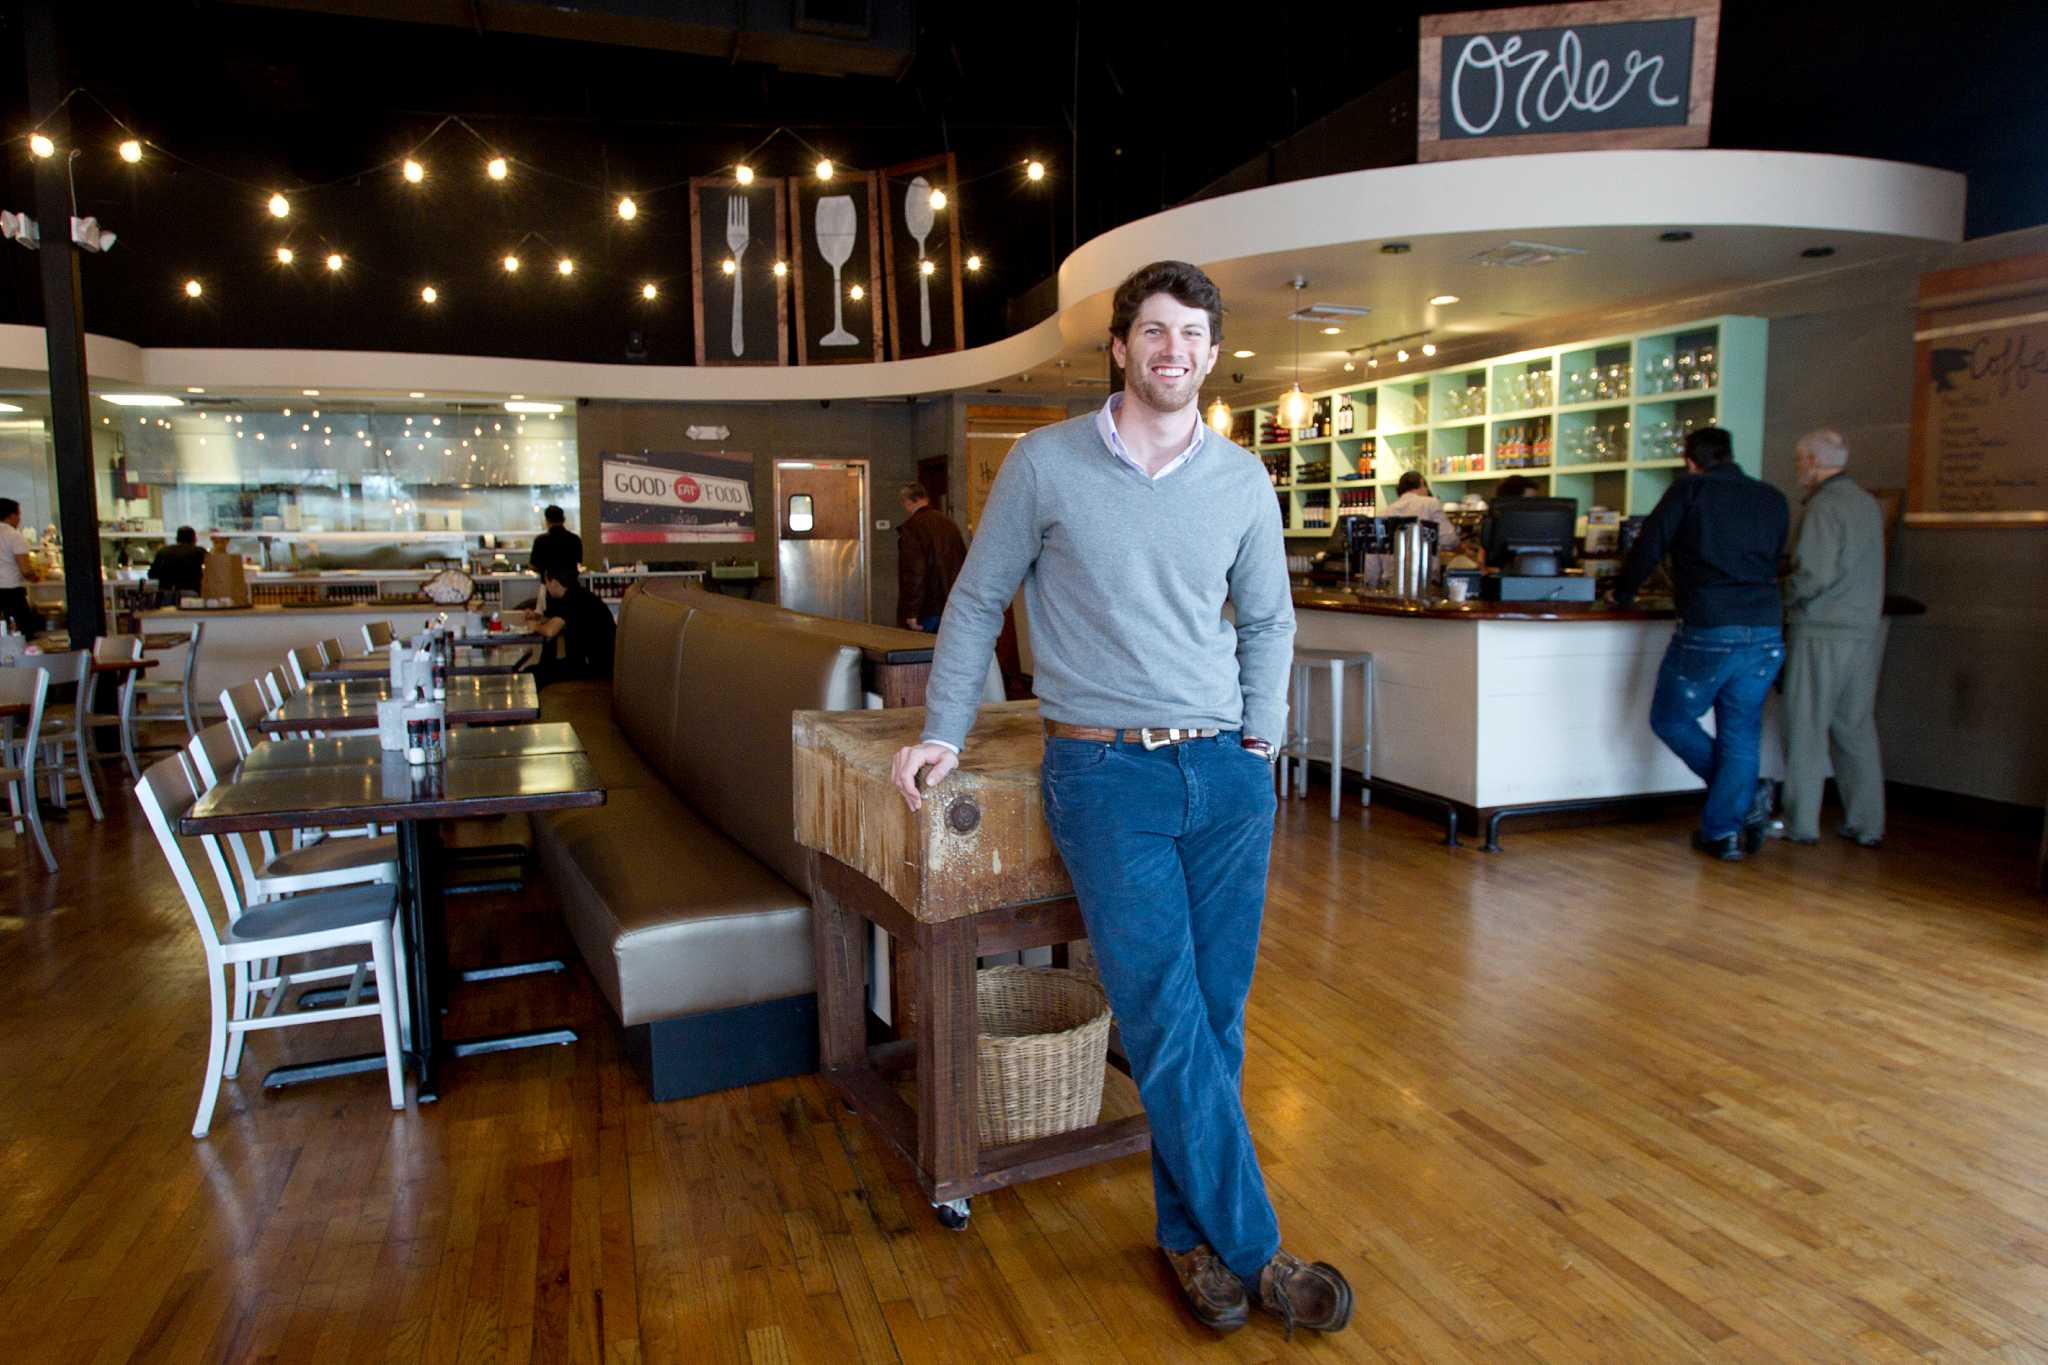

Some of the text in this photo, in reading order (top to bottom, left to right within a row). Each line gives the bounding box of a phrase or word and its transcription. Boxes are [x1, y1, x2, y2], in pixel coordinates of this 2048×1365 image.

[1452, 30, 1679, 134] Order
[615, 473, 742, 503] GOOD EAT FOOD
